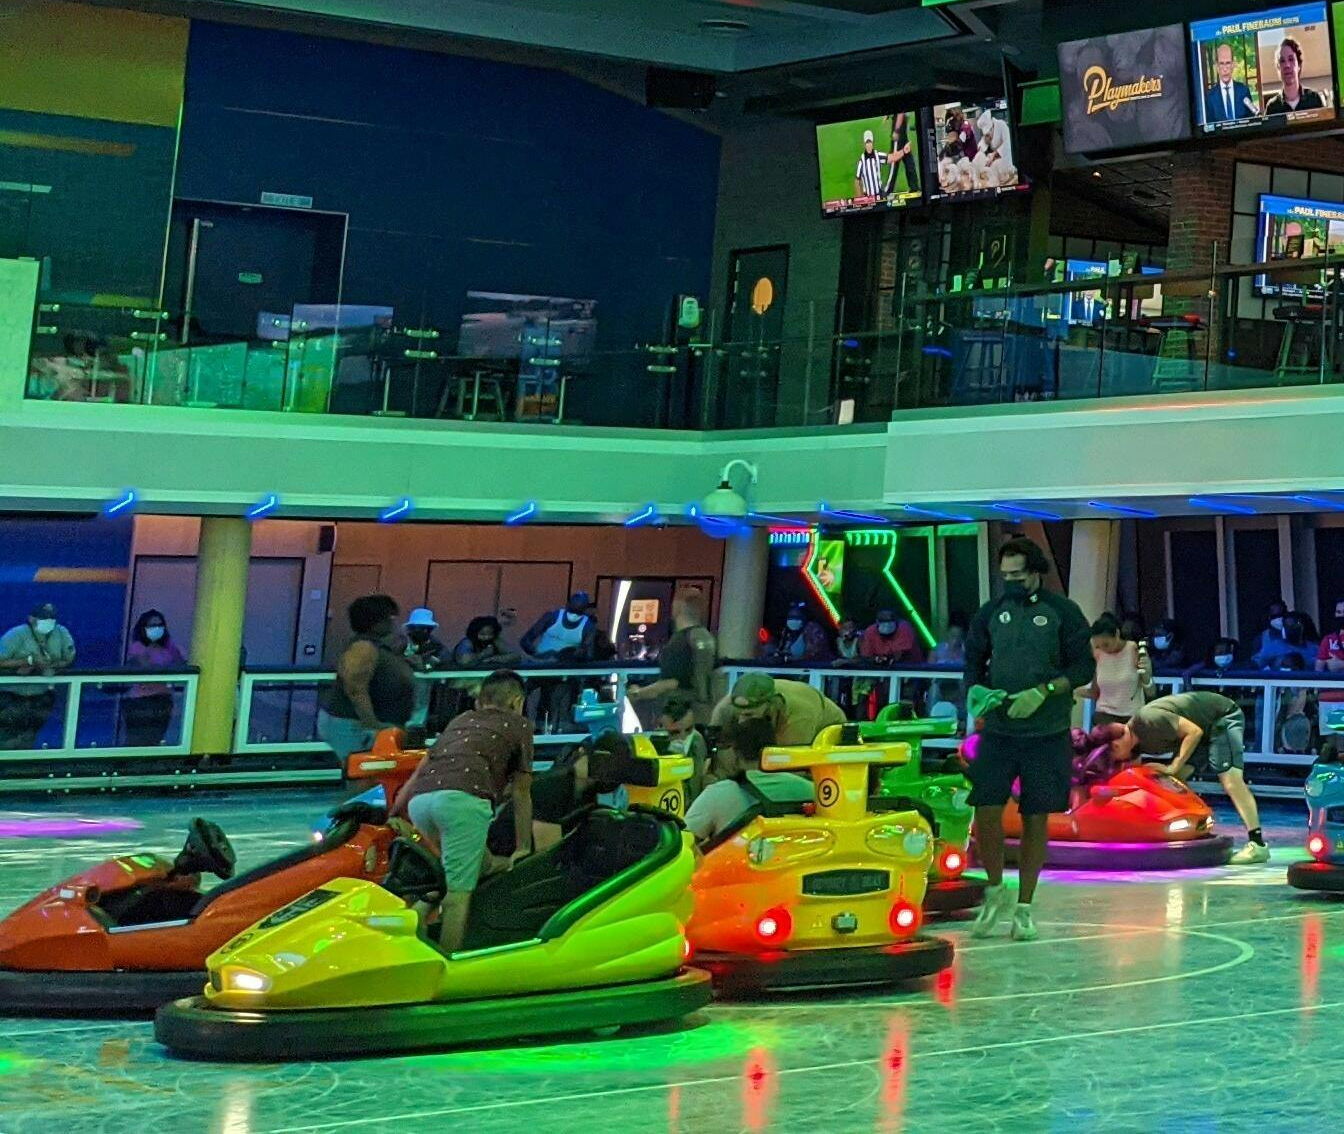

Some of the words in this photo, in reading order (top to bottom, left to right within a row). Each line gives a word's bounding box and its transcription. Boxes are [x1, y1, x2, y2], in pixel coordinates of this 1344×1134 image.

[1083, 65, 1163, 115] Playmakers
[822, 785, 832, 801] 9
[662, 795, 679, 812] 10
